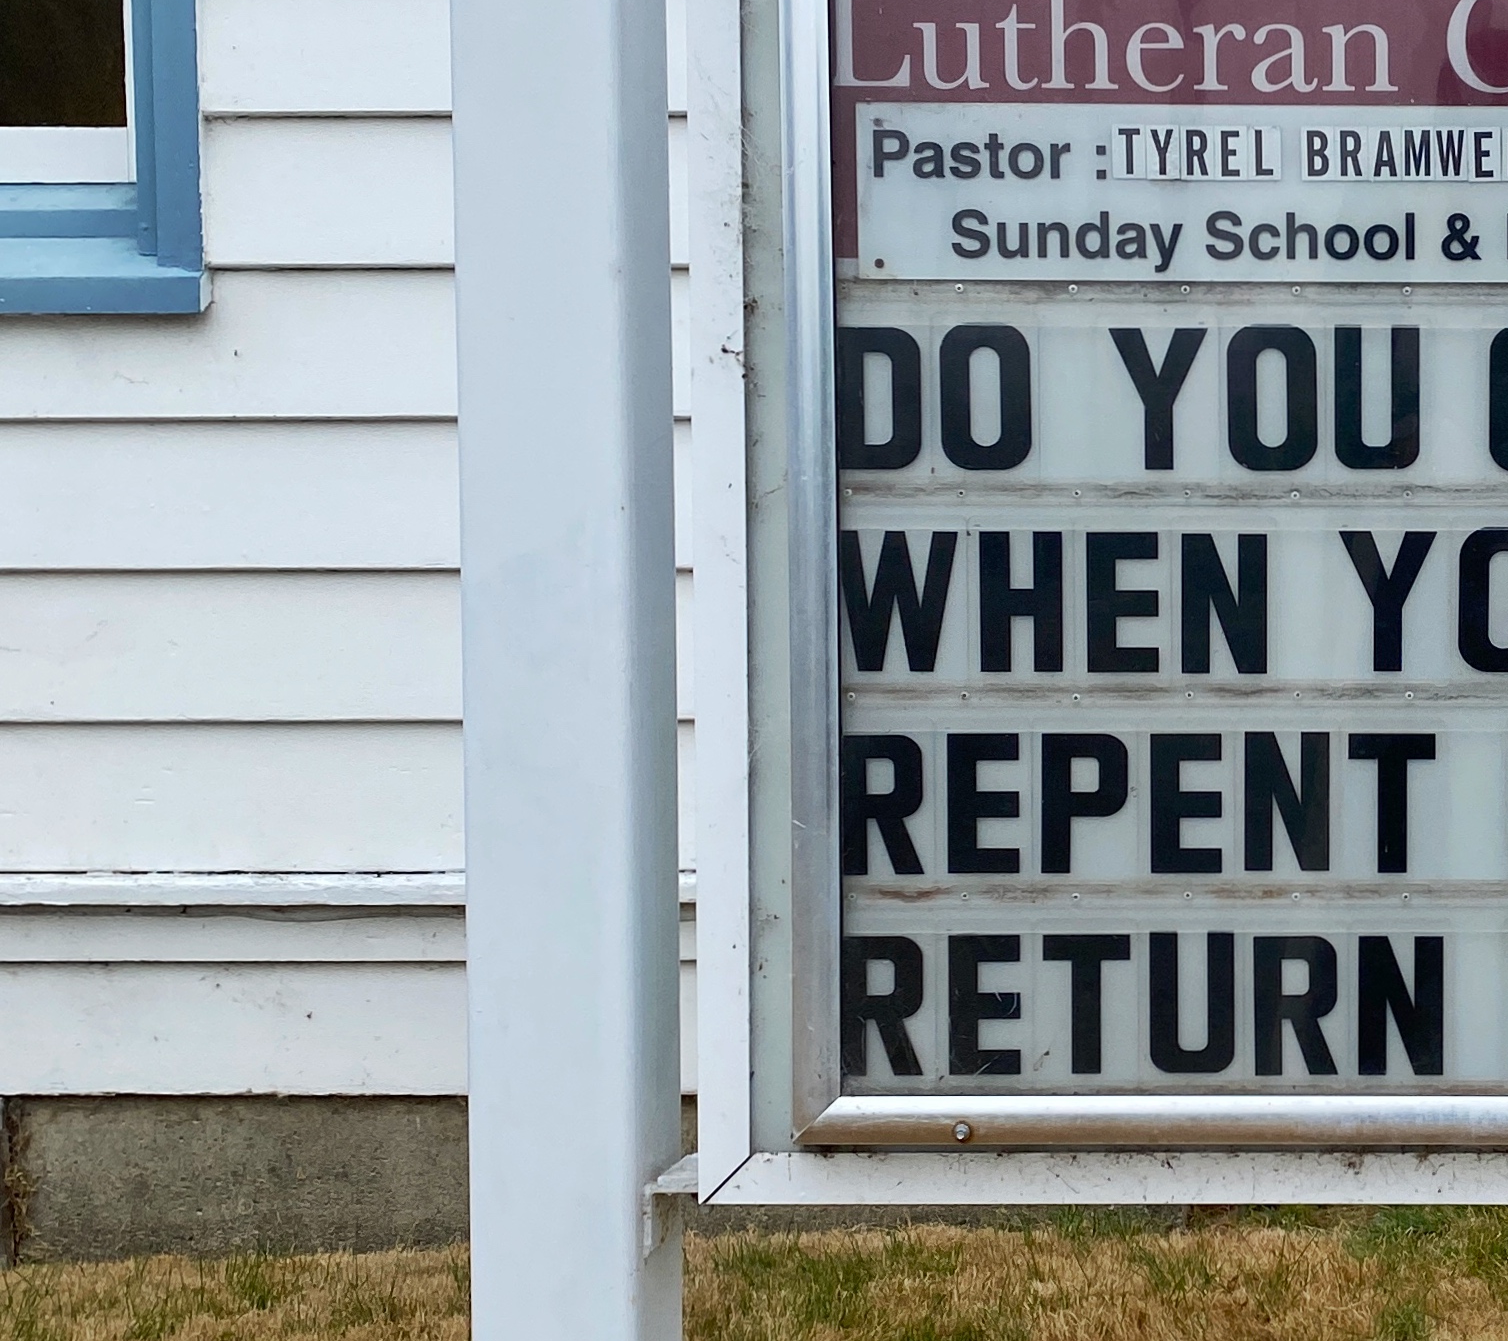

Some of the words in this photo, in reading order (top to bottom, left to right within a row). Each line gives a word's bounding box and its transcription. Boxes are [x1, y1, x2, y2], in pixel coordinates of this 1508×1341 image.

[1118, 127, 1274, 177] TYREL
[951, 208, 1183, 272] Sunday
[1205, 210, 1415, 261] School
[1441, 214, 1480, 260] &
[839, 324, 1032, 470] DO
[1108, 324, 1421, 470] YOU
[842, 530, 1268, 674] WHEN
[842, 731, 1436, 875] REPENT
[843, 932, 1444, 1076] RETURN
